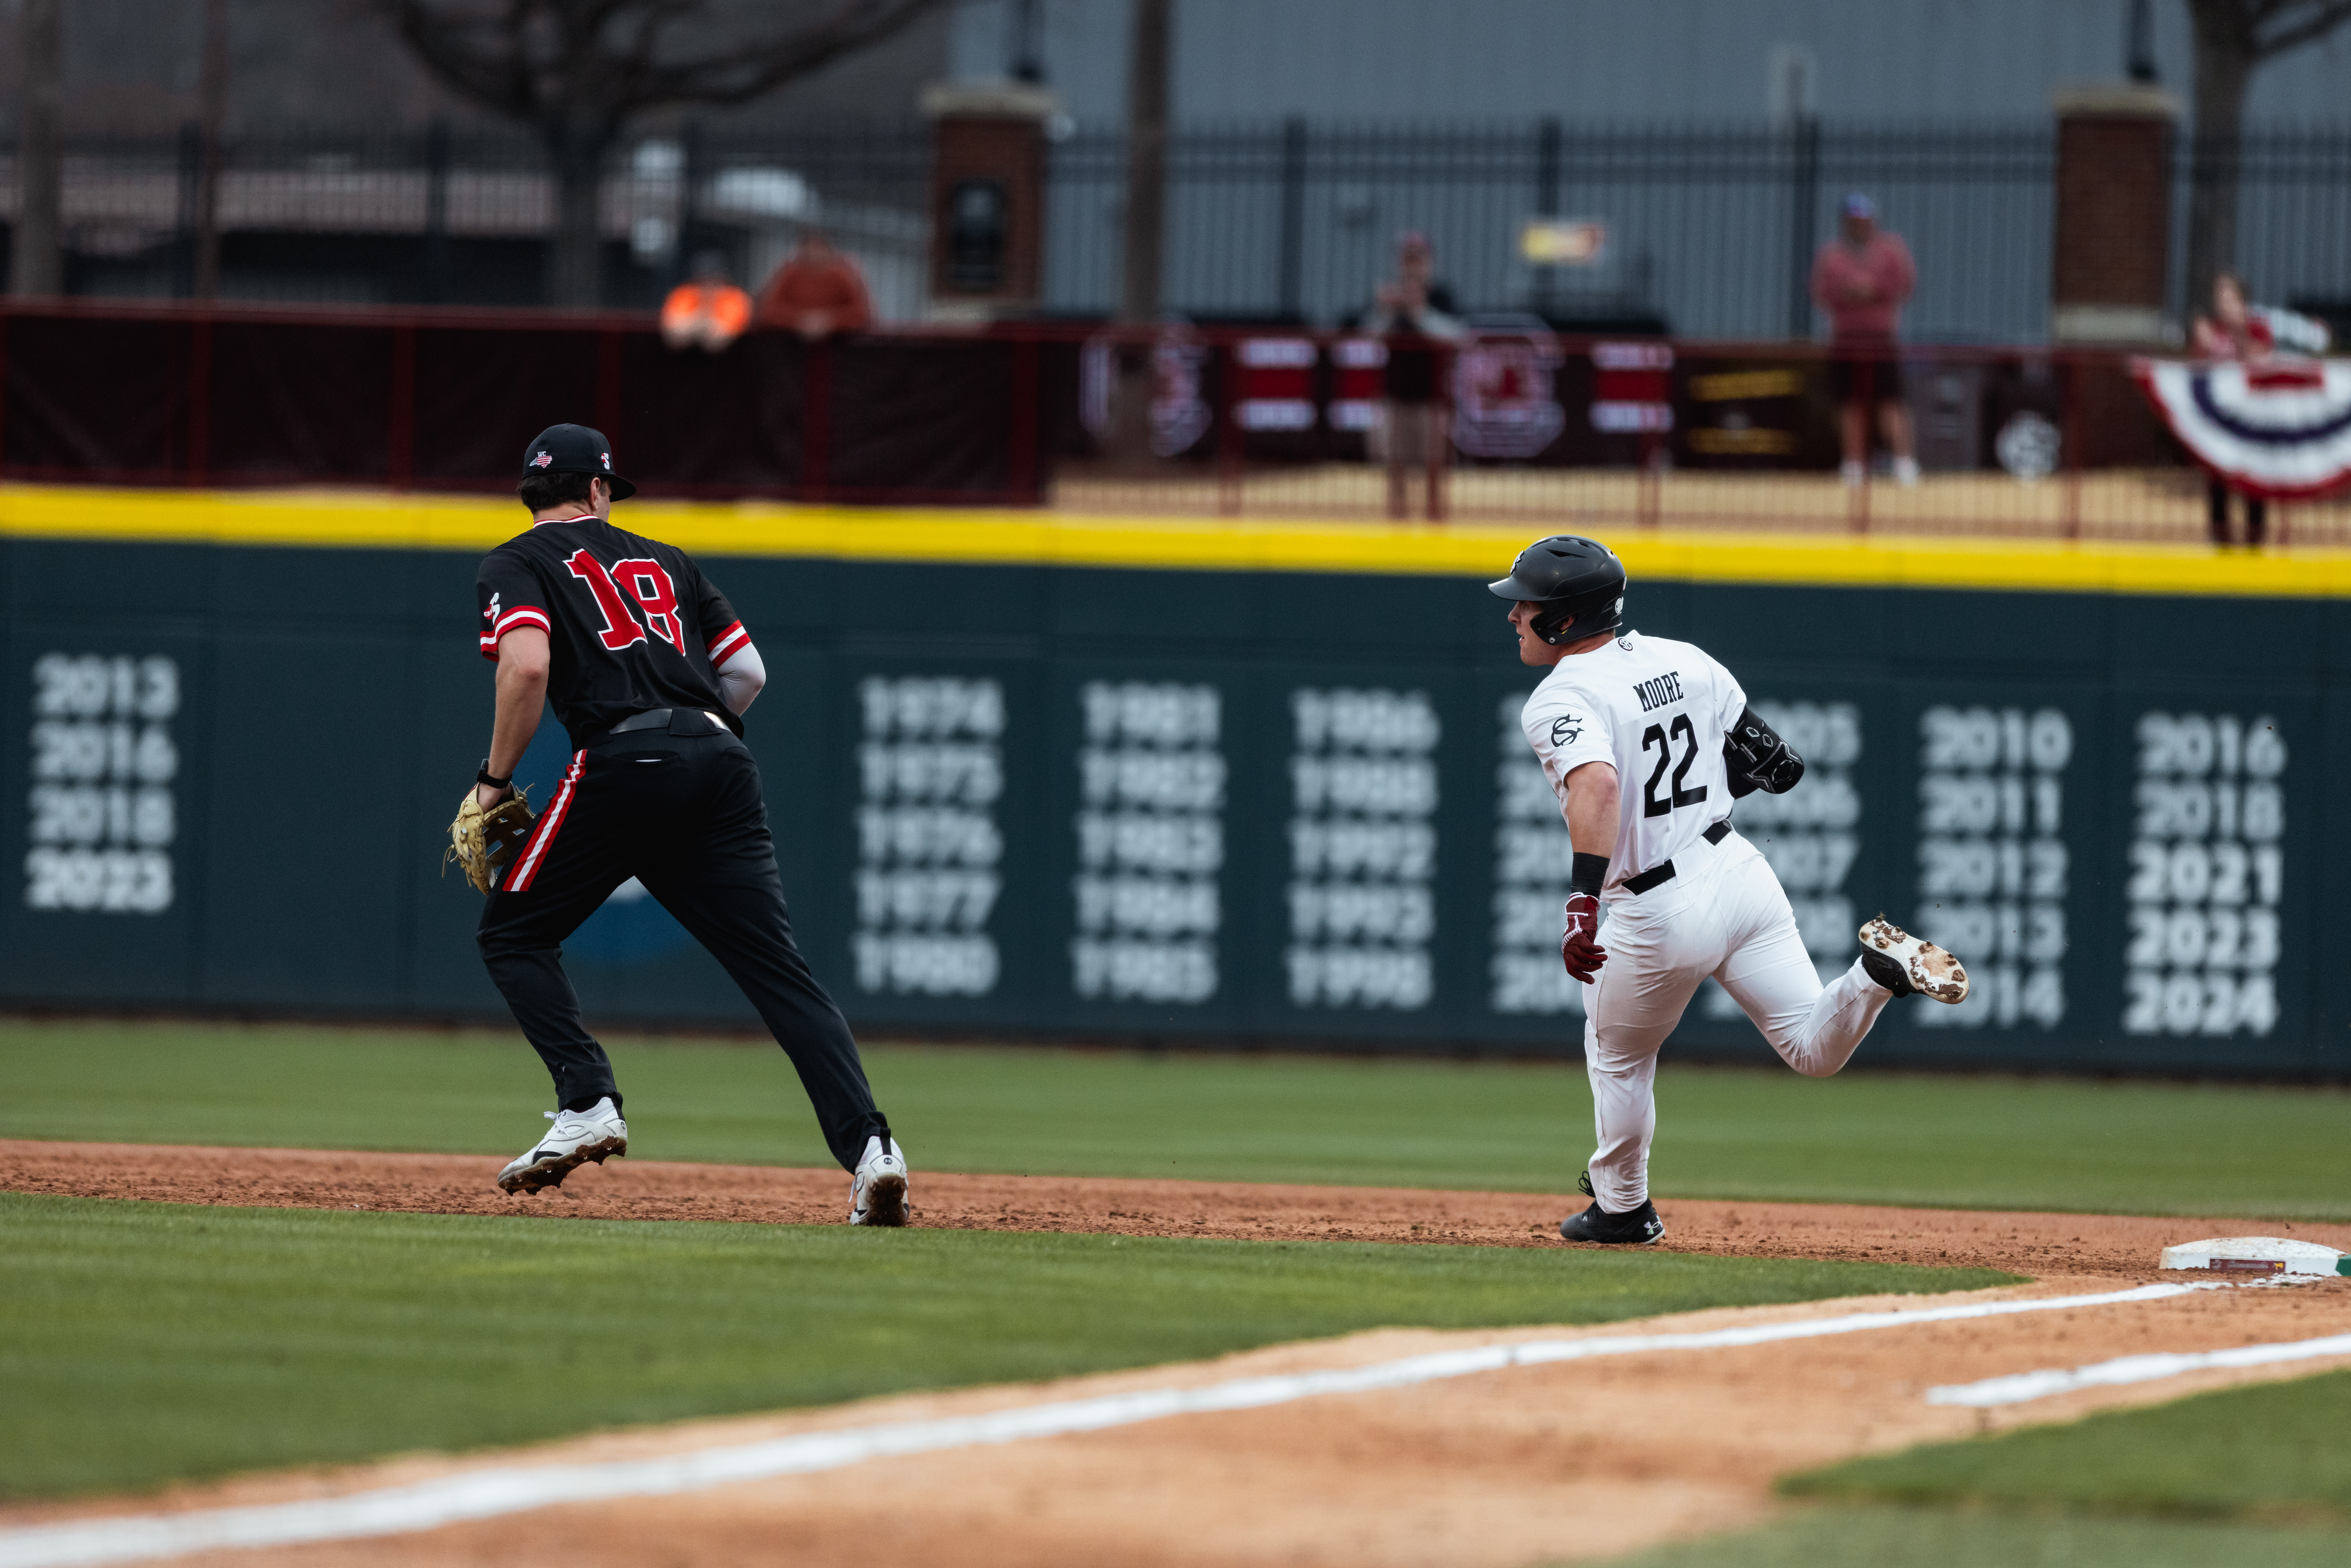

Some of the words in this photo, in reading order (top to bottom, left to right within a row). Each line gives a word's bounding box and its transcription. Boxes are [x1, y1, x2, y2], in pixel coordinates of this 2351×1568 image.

[563, 548, 686, 656] 18
[36, 655, 178, 719] 2013
[1633, 671, 1684, 713] MOORE
[1641, 712, 1707, 819] 22
[1922, 707, 2072, 772] 2010
[2138, 714, 2286, 777] 2016
[1921, 772, 2061, 835] 2011
[2136, 778, 2283, 839] 2018
[26, 845, 173, 913] 2023
[856, 865, 999, 927] 1977
[1919, 835, 2068, 899] 2012
[2127, 840, 2282, 905] 2021
[2125, 906, 2280, 970] 2023
[2123, 971, 2279, 1035] 2024
